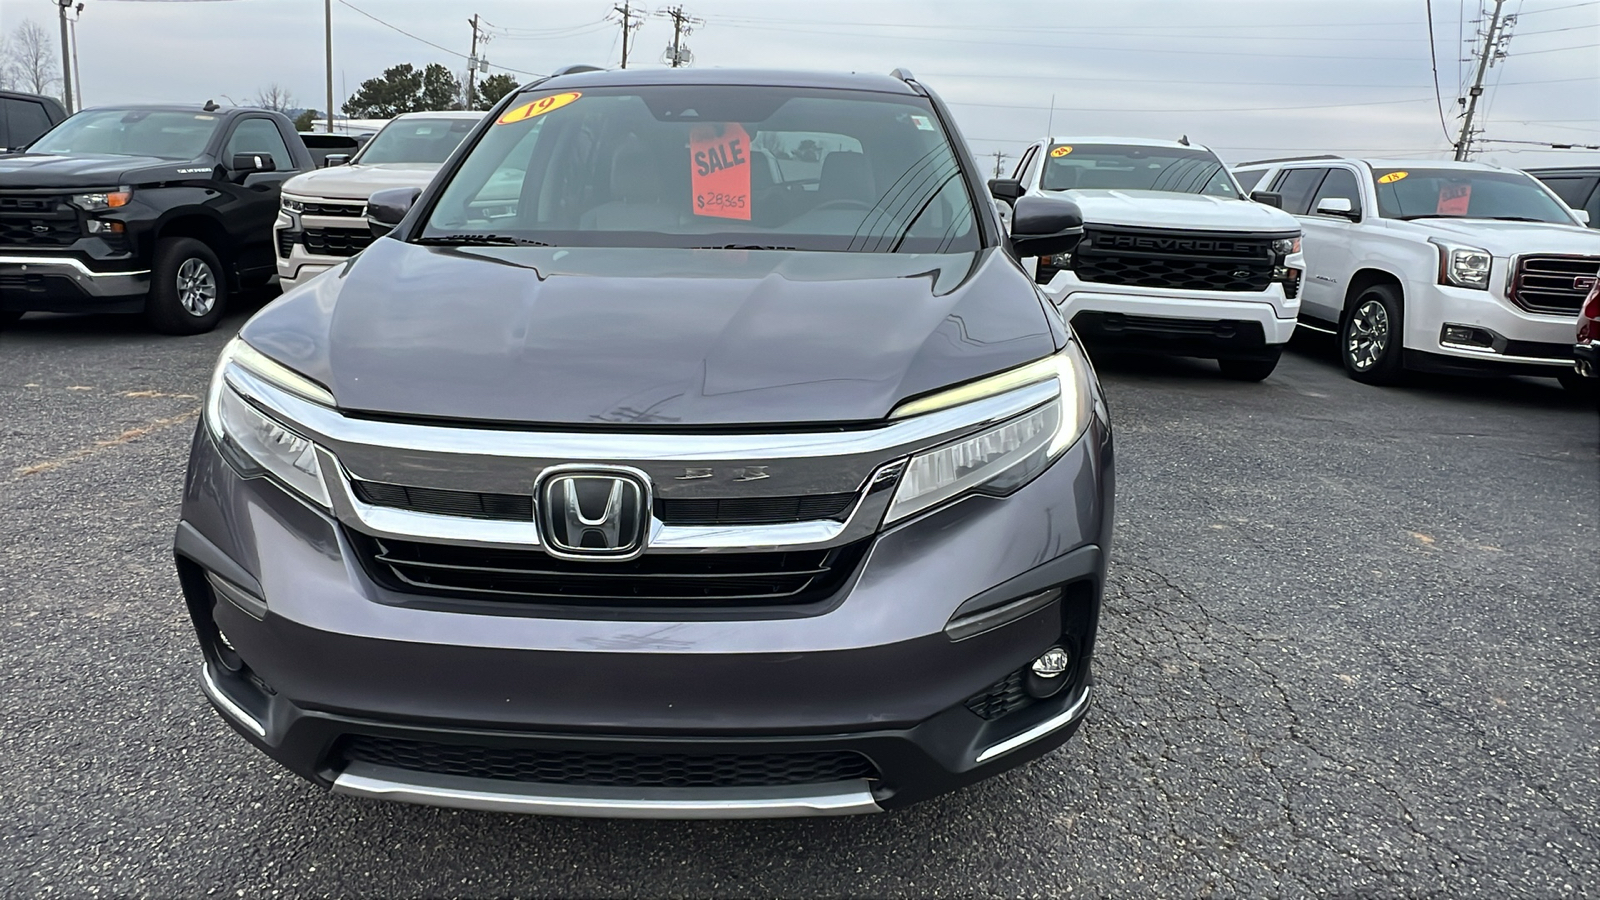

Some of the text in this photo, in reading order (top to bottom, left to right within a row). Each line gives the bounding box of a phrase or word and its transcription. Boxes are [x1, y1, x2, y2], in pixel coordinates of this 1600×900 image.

[523, 96, 556, 118] 19
[694, 138, 746, 177] SALE
[1096, 234, 1268, 254] CHEVROLET
